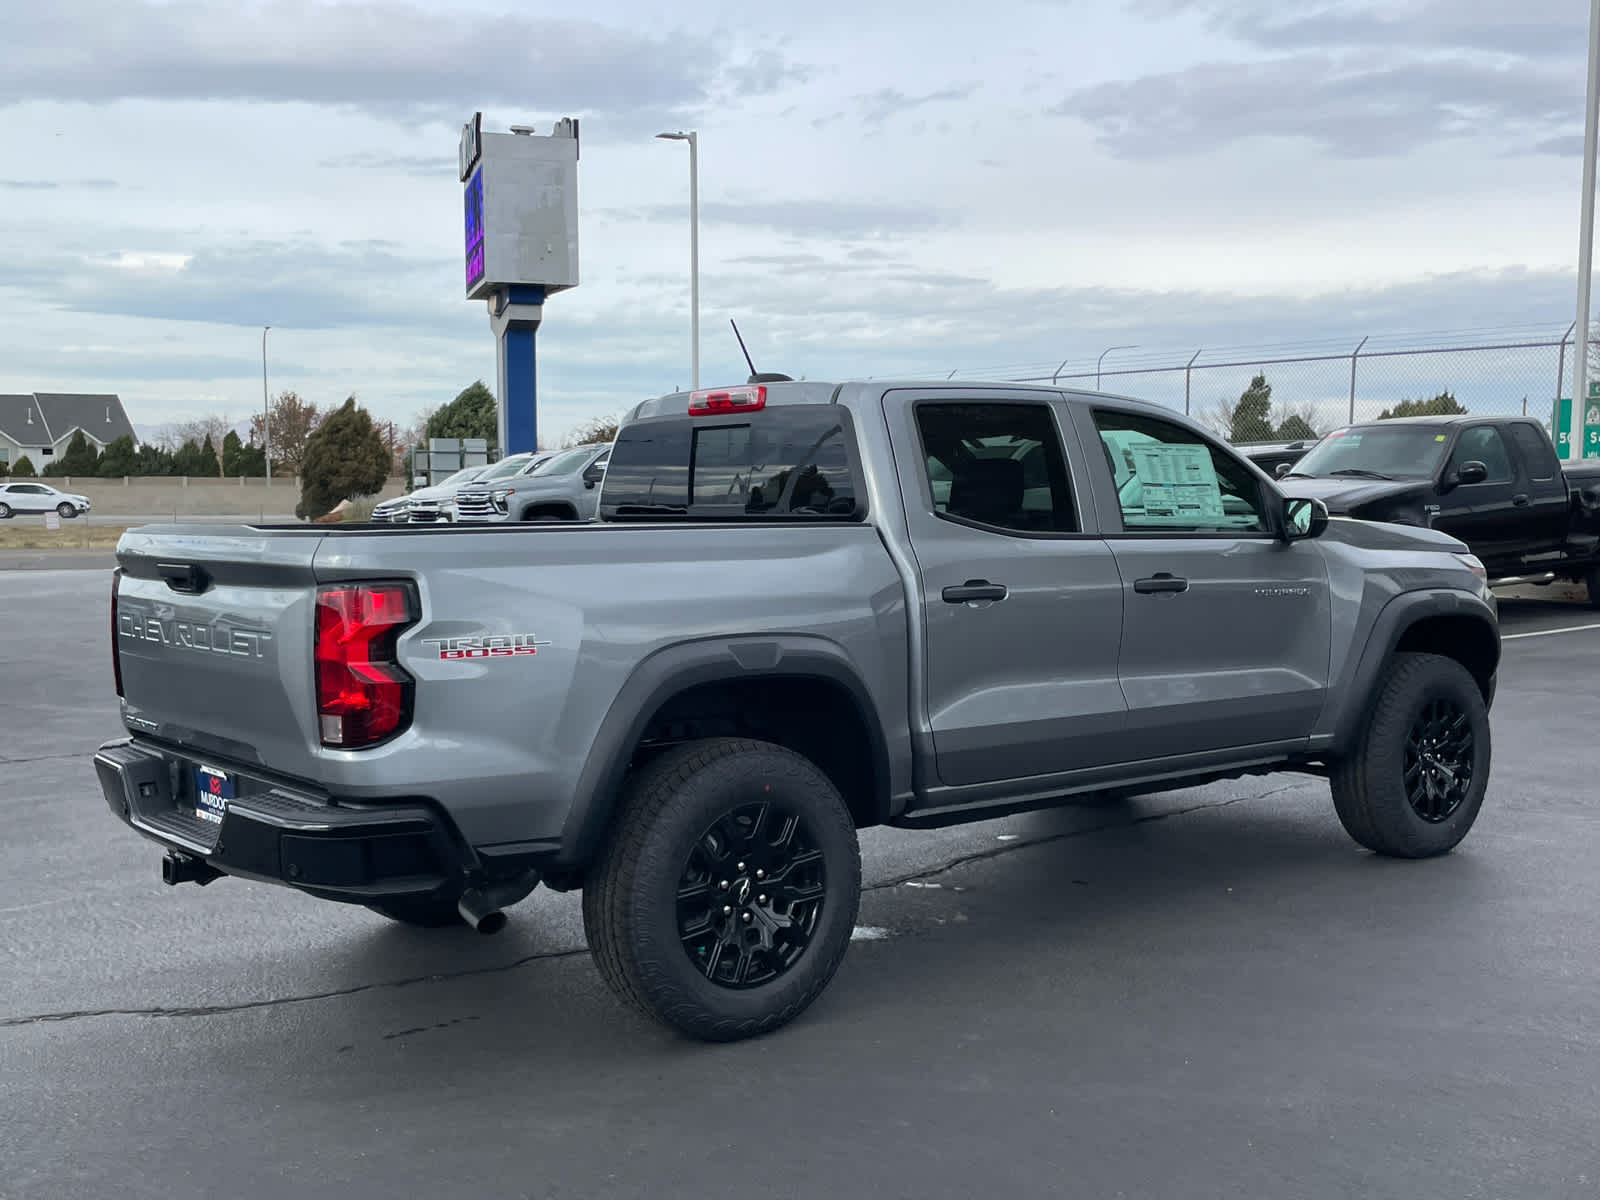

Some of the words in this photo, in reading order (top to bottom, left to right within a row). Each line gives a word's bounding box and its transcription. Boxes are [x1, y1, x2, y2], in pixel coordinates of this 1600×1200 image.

[119, 615, 272, 658] CHEVROLET
[421, 633, 552, 650] TRAIL
[440, 646, 536, 660] BOSS
